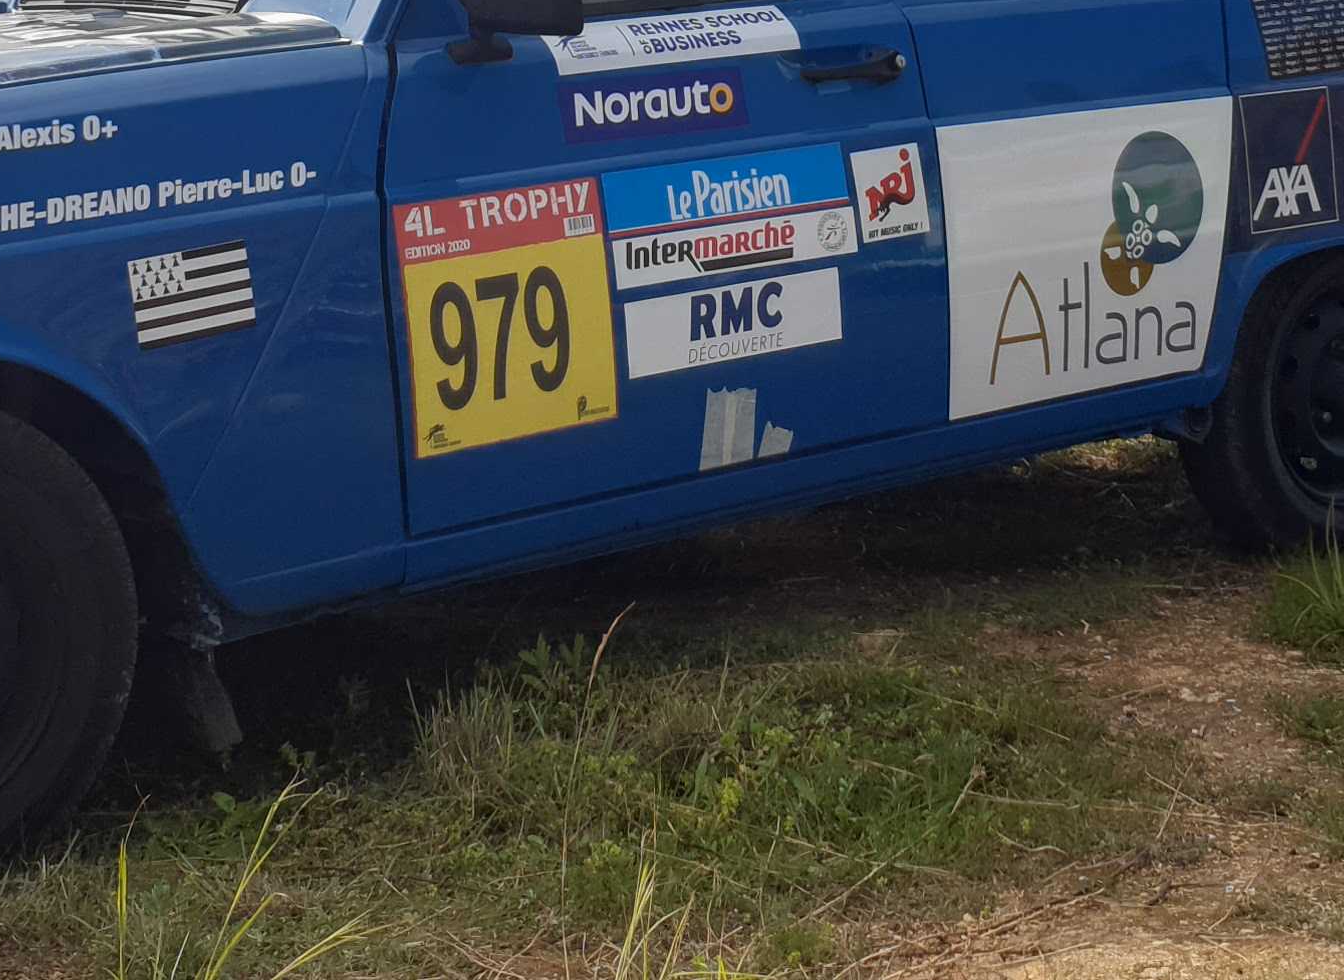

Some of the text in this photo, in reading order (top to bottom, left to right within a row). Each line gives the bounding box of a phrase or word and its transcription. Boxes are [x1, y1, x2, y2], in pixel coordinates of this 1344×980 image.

[628, 10, 785, 37] RENNES SCHOOL
[650, 30, 743, 54] BUSINESS
[573, 80, 735, 128] Norauto
[158, 169, 284, 207] Pierre-Luc
[404, 181, 590, 238] 4L TROPHY
[668, 170, 792, 221] Le Parisien
[1253, 163, 1322, 221] AXA
[405, 238, 471, 260] EDITION 2020
[689, 281, 785, 342] RMC
[989, 262, 1197, 386] Atlana
[429, 265, 571, 411] 979
[687, 332, 785, 365] DÉCOUVERTE
